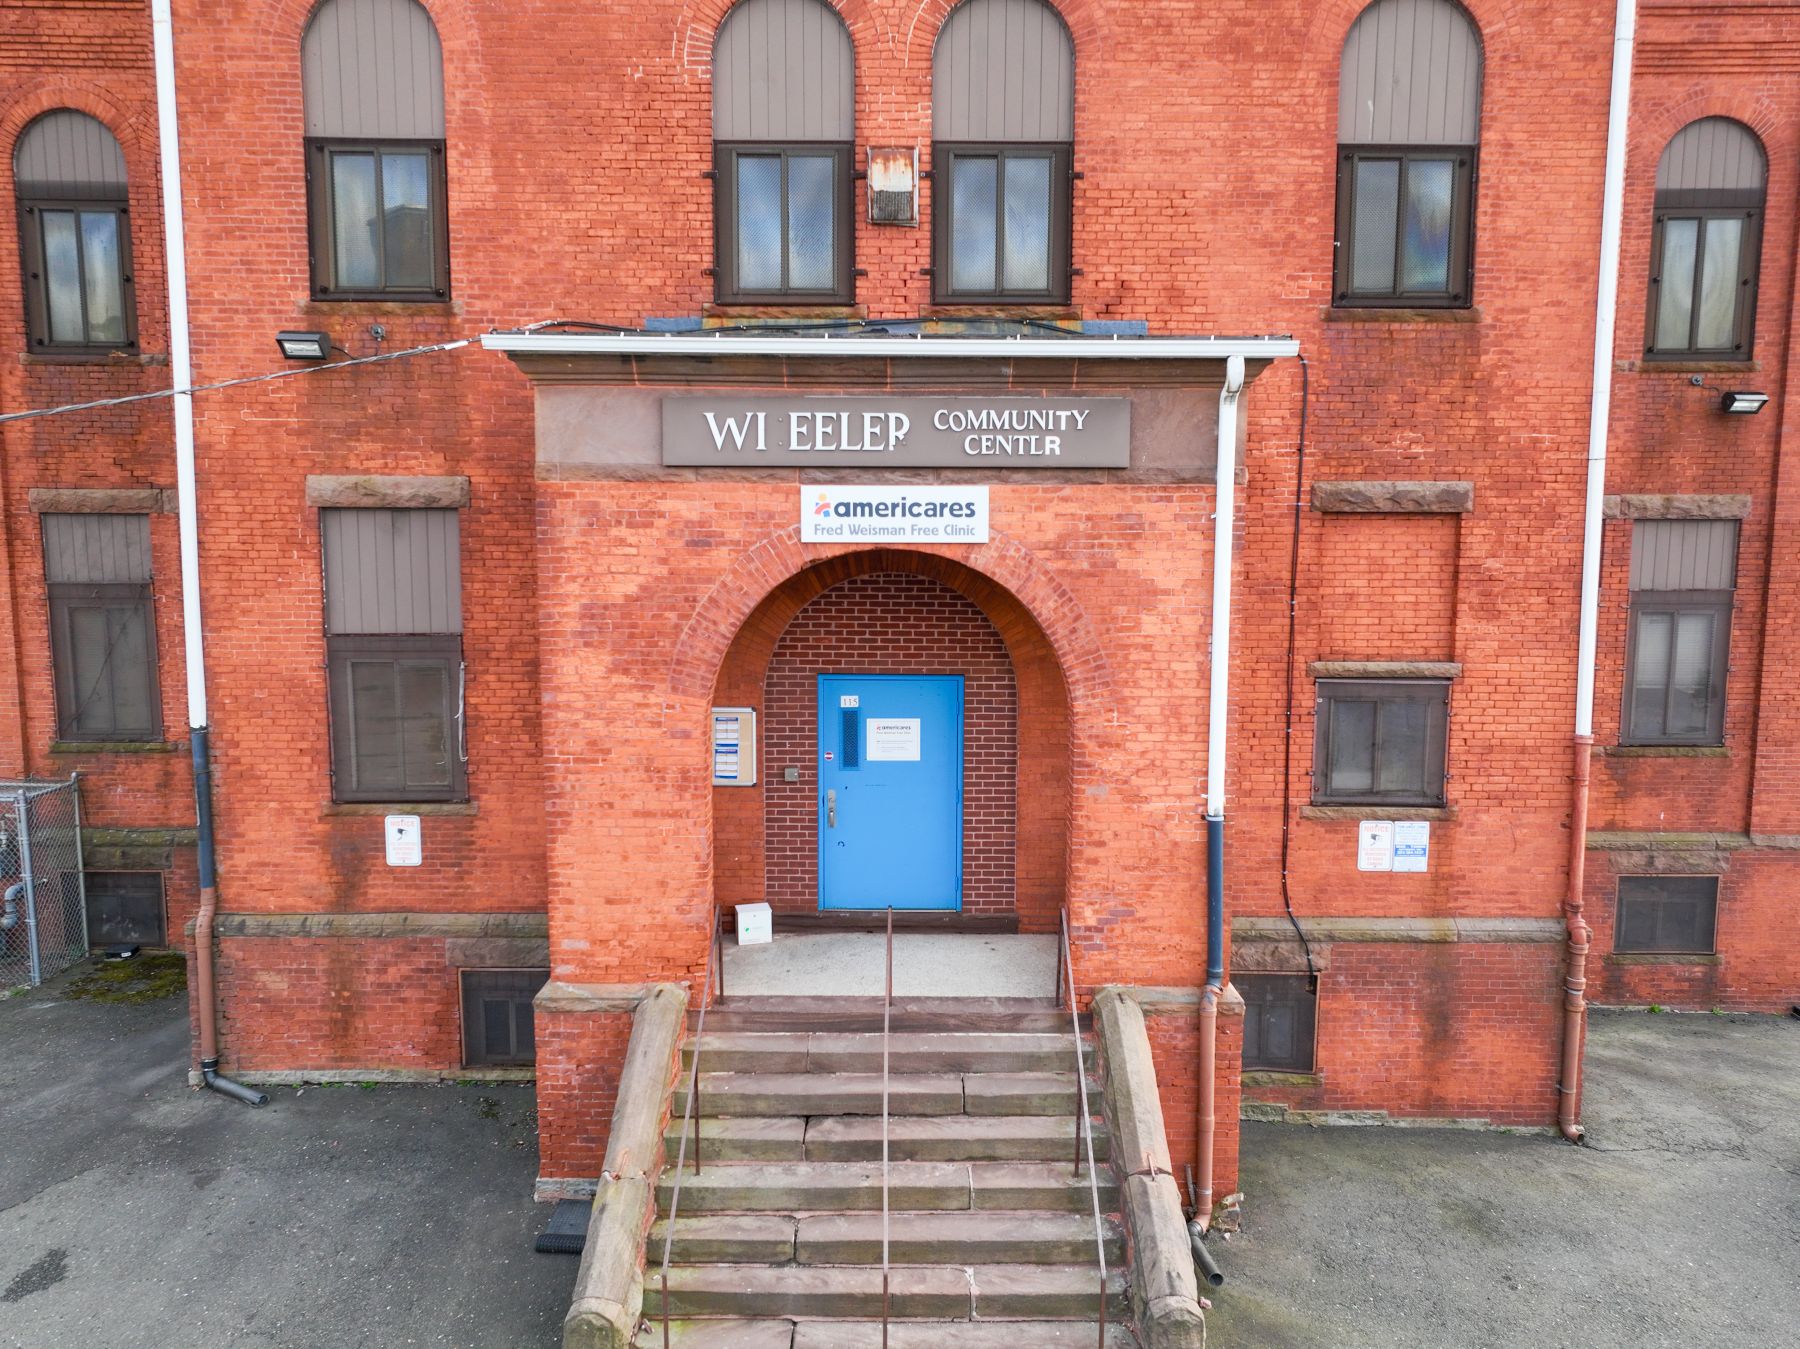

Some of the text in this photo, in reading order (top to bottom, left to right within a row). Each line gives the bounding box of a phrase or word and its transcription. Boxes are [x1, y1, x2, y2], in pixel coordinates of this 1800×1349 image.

[933, 409, 1090, 431] COMMUNITY
[833, 496, 976, 518] americares
[814, 524, 976, 536] Fred Weisman Free Clinic
